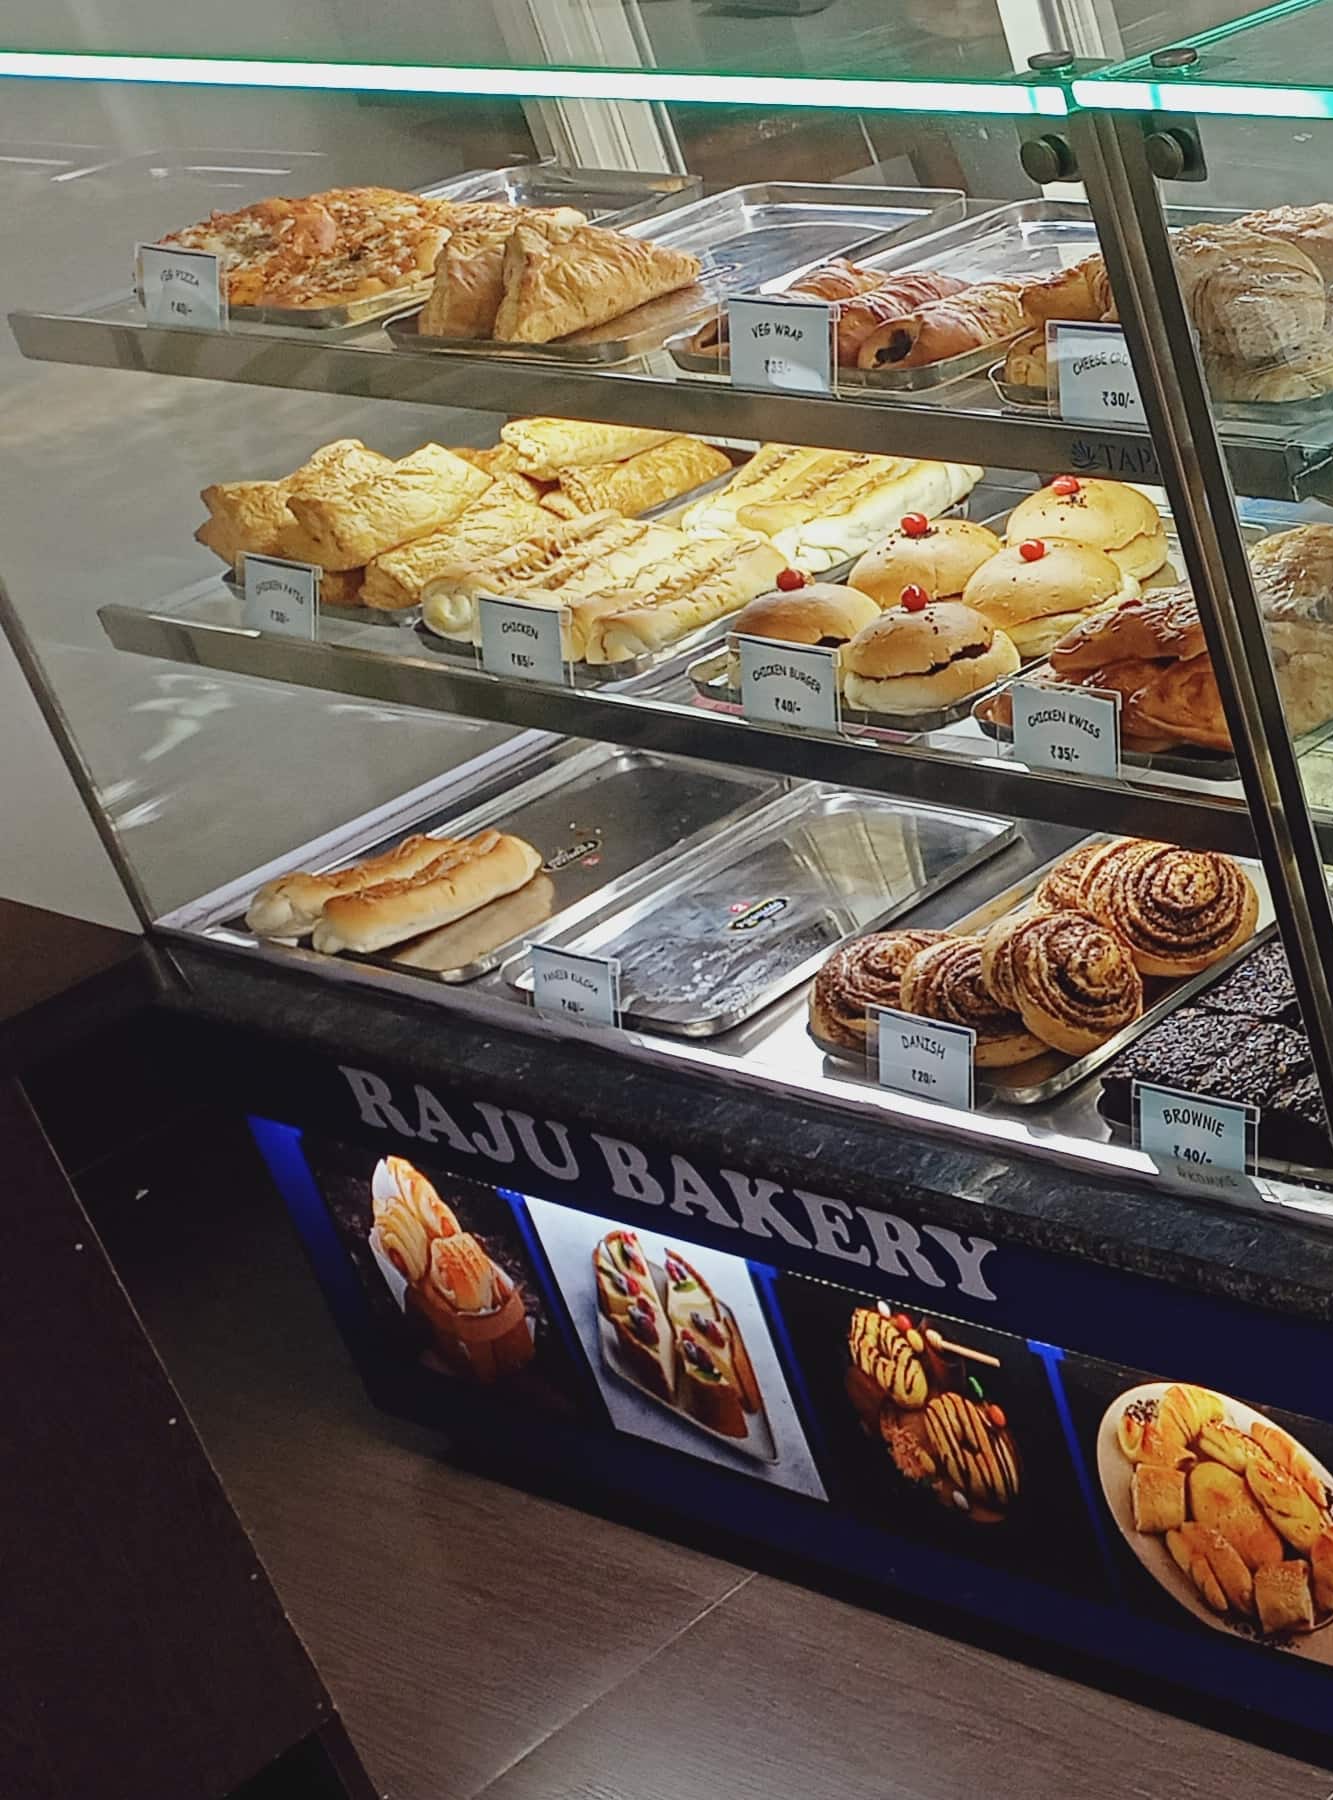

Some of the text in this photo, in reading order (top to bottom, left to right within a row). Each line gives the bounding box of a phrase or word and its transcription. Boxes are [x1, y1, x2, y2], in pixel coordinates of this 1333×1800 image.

[751, 322, 803, 341] VEG WRAP
[1072, 351, 1107, 376] CHEESE
[1102, 391, 1135, 408] ₹30/-
[1100, 444, 1158, 475] TAP
[501, 621, 539, 640] CHICKEN
[752, 664, 822, 695] CHICKEN BURGER
[1028, 708, 1101, 739] CHICKEN KWISS
[901, 1034, 946, 1060] DANISH
[1162, 1108, 1225, 1138] BROWNIE
[338, 1065, 999, 1301] RAJU BAKERY
